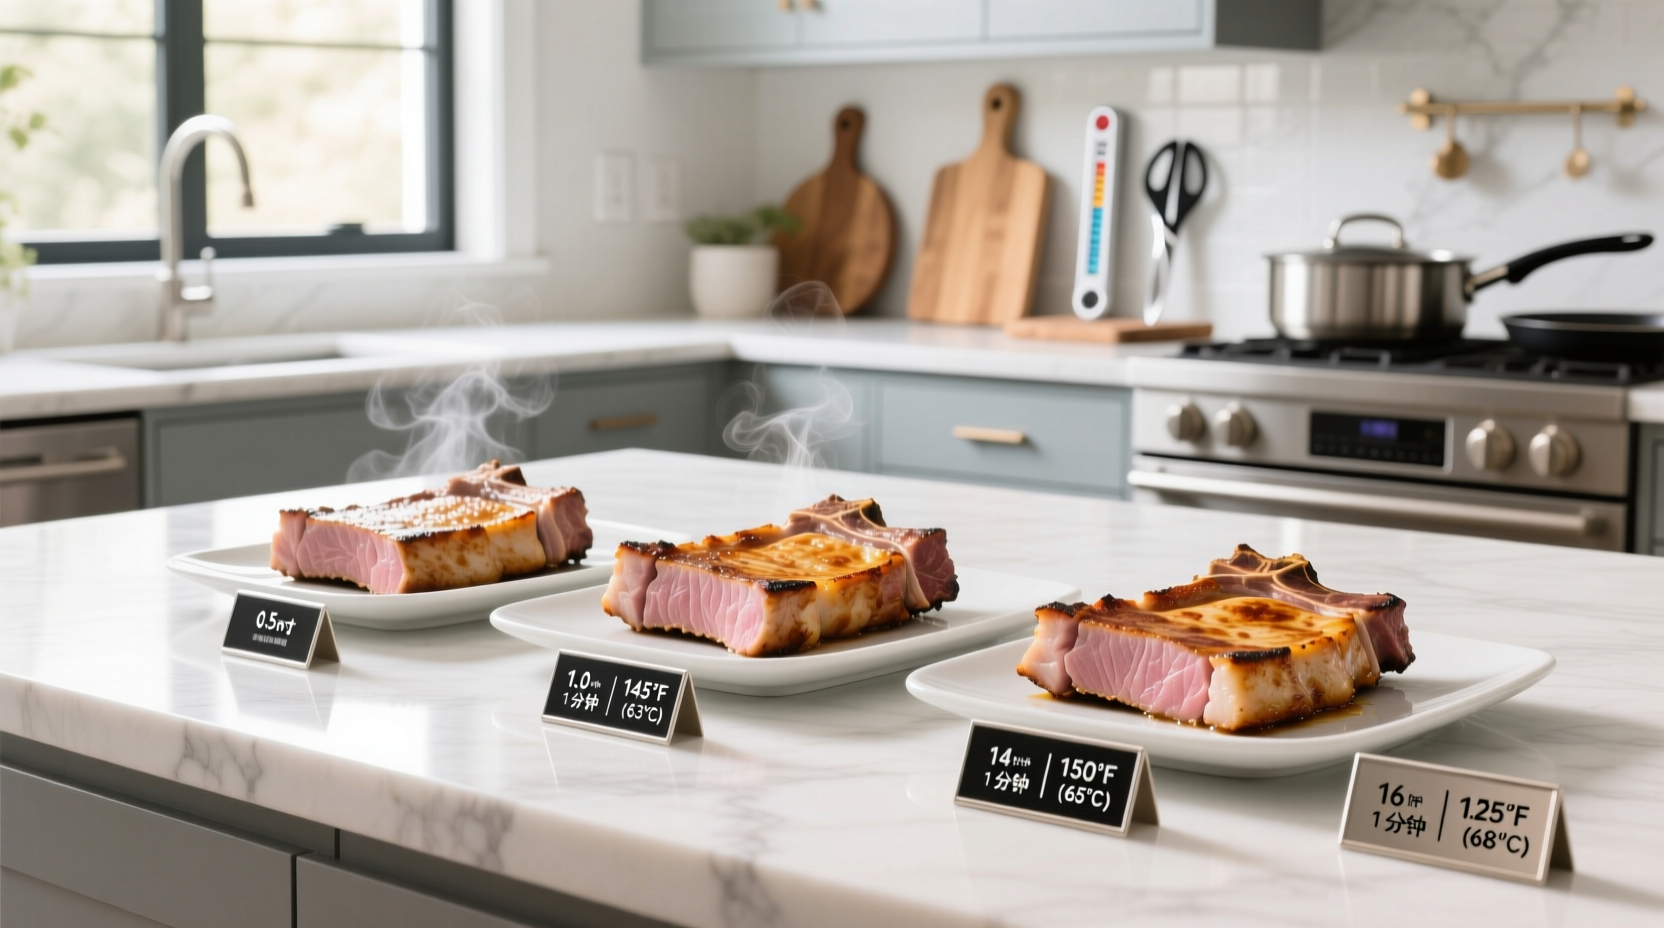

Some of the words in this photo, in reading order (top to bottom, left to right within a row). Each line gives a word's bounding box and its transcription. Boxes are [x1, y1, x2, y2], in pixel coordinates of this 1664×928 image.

[1061, 757, 1118, 784] 150°F
[1058, 784, 1111, 812] (65°C)
[1460, 797, 1530, 826] 1.25°F
[1462, 826, 1530, 858] (68°C)
